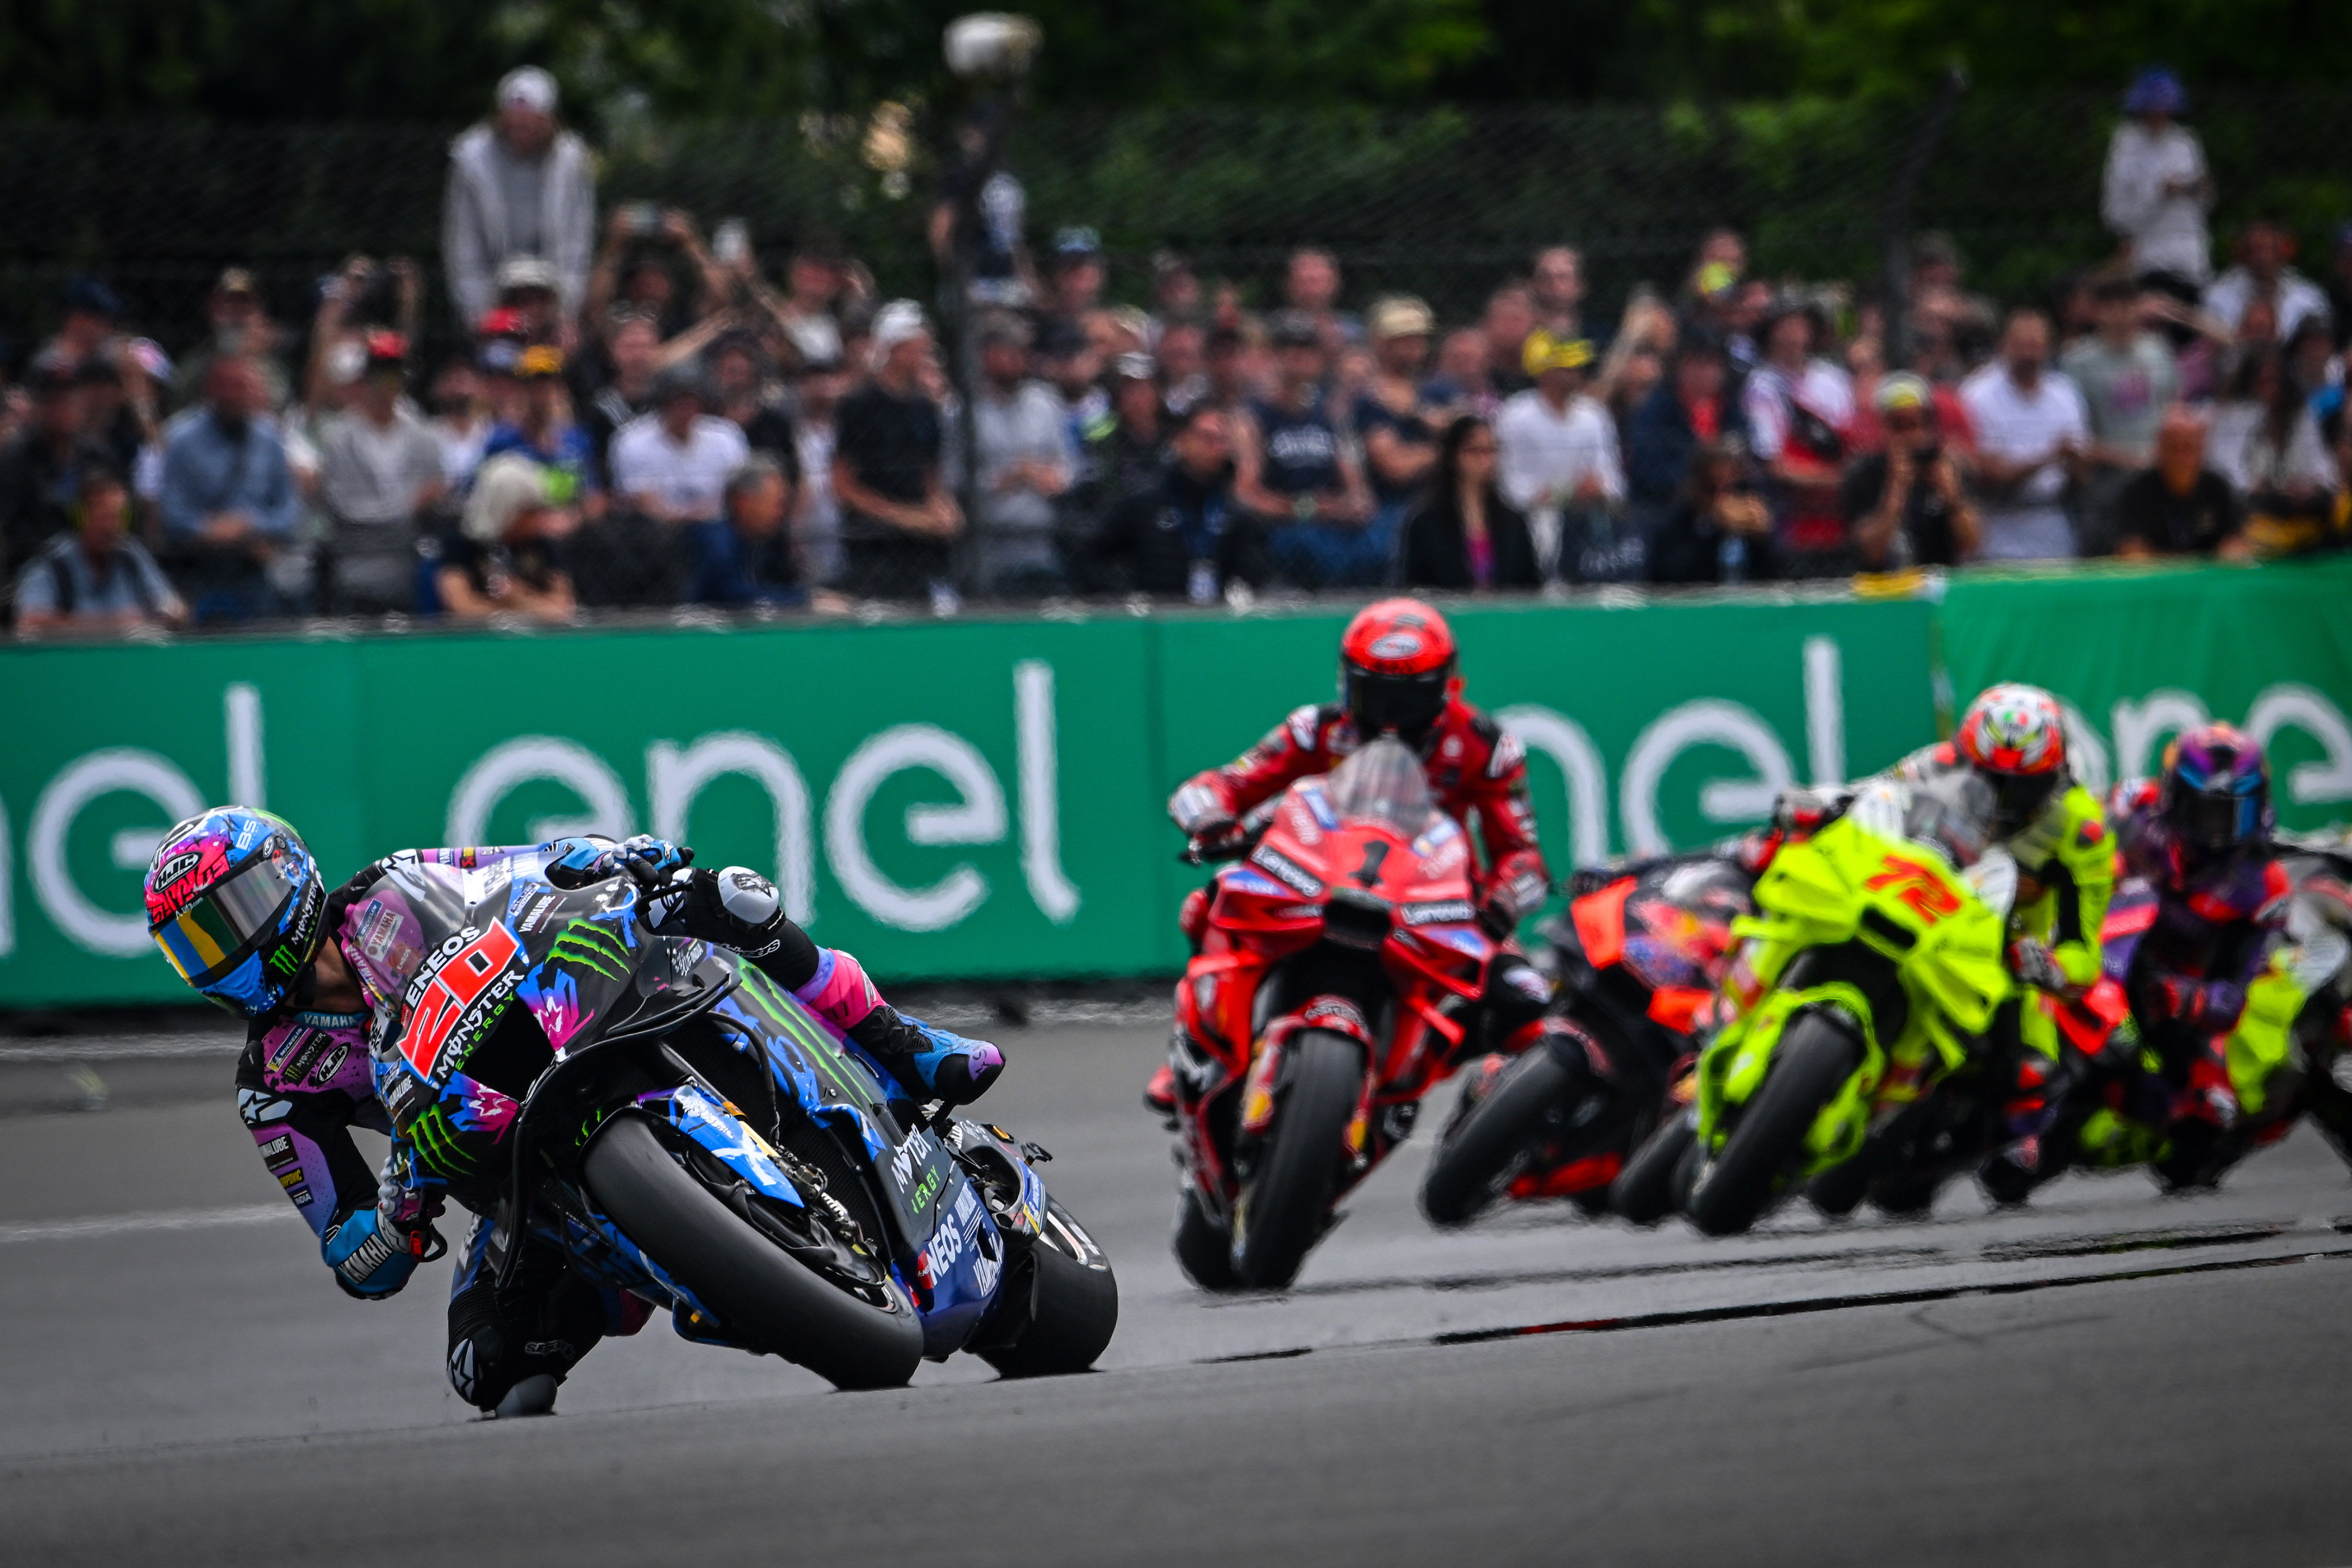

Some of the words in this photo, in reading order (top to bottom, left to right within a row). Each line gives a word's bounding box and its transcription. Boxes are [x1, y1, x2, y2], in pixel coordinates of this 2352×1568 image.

[445, 660, 1081, 933] enel
[236, 820, 257, 850] BS
[157, 854, 195, 888] HJC
[1348, 839, 1391, 887] 1
[291, 881, 318, 945] MONSTER
[518, 895, 556, 932] YAMALUBE
[1866, 855, 1962, 927] 72
[371, 912, 396, 946] YAMAHA
[406, 926, 480, 1008] ENEOS
[304, 1013, 356, 1028] YAMAHA
[397, 917, 519, 1081] 20
[280, 1028, 303, 1055] MICHELIN
[436, 970, 525, 1079] MONSTER
[454, 991, 516, 1071] ENERGY
[297, 1032, 326, 1068] MONSTER
[319, 1046, 348, 1080] HJC
[338, 1233, 393, 1285] YAMAHA
